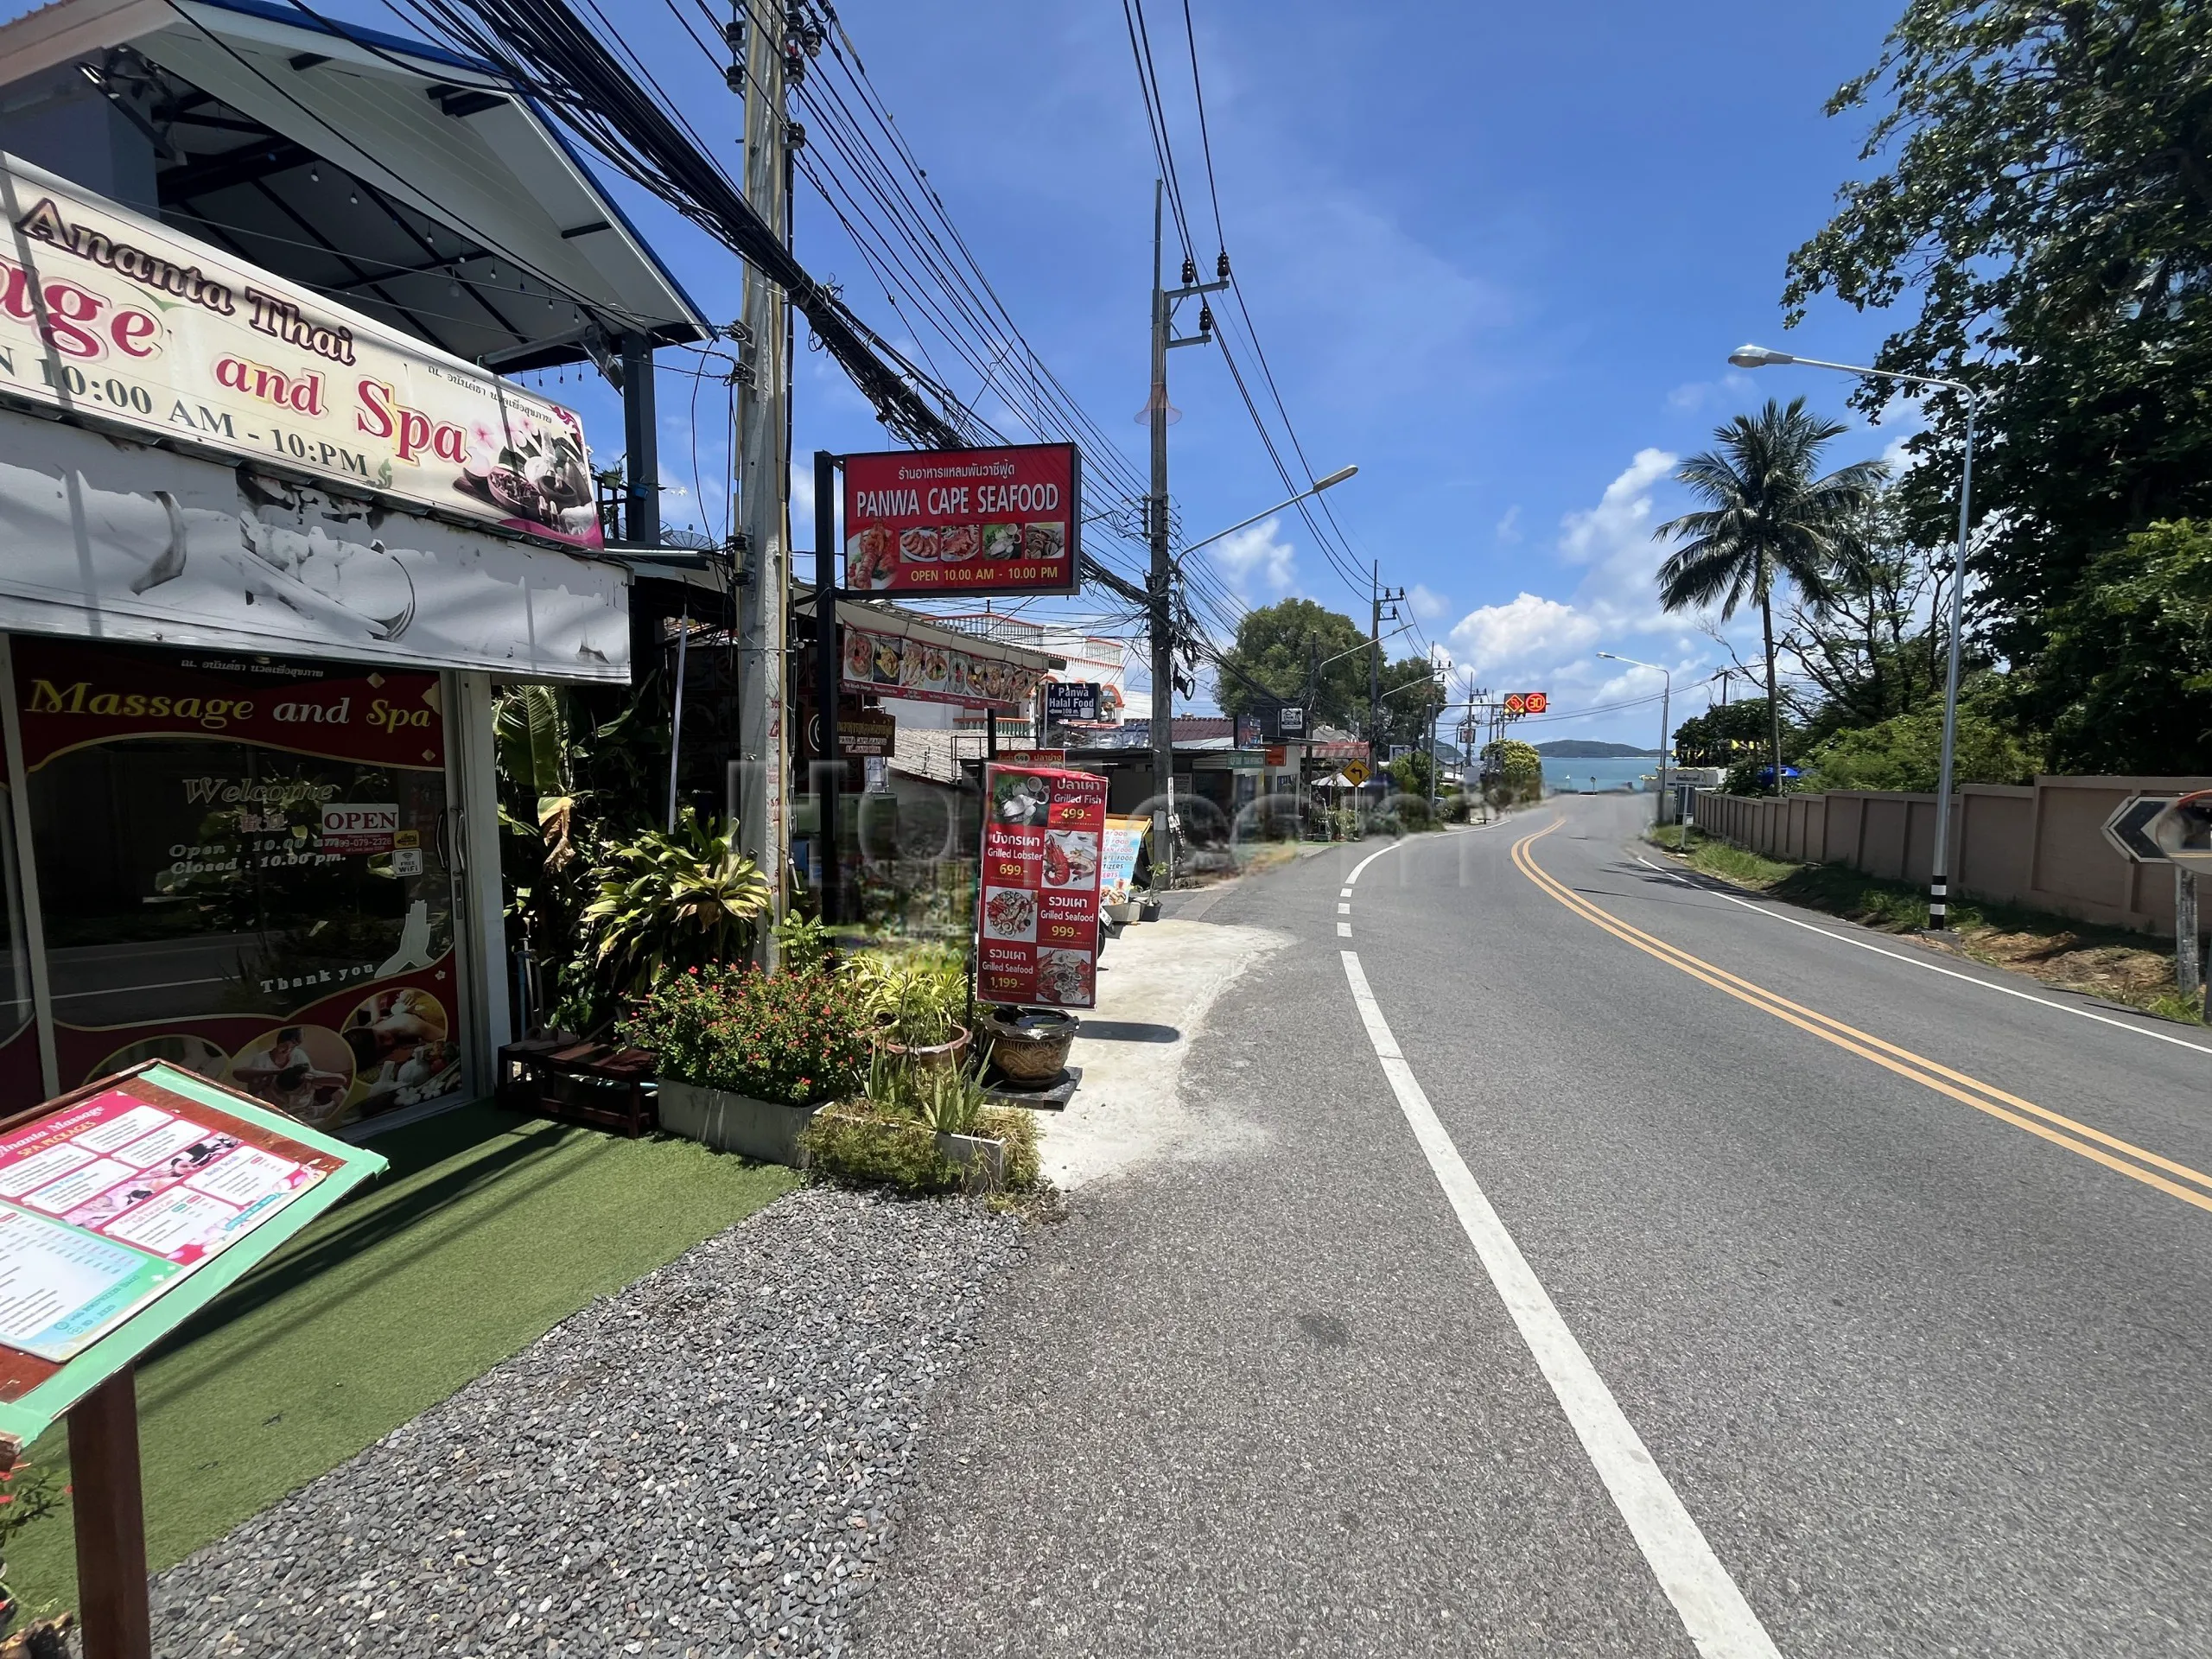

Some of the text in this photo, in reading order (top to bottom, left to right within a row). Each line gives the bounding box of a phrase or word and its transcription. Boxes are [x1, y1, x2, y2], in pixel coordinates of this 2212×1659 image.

[17, 198, 356, 366] Ananta Thai
[35, 359, 152, 414] 10:00
[169, 399, 236, 441] AM
[274, 429, 369, 477] 10:PM
[216, 358, 325, 417] and
[358, 379, 468, 464] Spa
[856, 483, 1059, 518] PANWA CAPE SEAFOOD
[911, 569, 938, 582] OPEN
[944, 569, 971, 581] 10.00
[976, 569, 995, 580] AM
[1008, 568, 1036, 579] 10.00
[1041, 567, 1058, 578] PM
[1058, 687, 1090, 697] Panwa
[24, 679, 432, 733] Massage and Spa
[1049, 698, 1095, 708] Halal Food
[1529, 696, 1543, 709] 30
[182, 777, 334, 804] Welcome
[1054, 793, 1102, 804] Grilled Fish
[324, 812, 397, 830] OPEN
[1061, 808, 1091, 819] 499.-
[168, 842, 226, 859] Open
[988, 847, 1043, 861] Grilled Lobster
[170, 857, 238, 874] Closed
[1040, 909, 1064, 919] Grilled
[1065, 910, 1095, 922] Seafood
[1052, 925, 1082, 937] 999.-
[982, 961, 1034, 975] Grilled Seafood
[260, 964, 374, 993] Thank you
[47, 1105, 105, 1133] Massage
